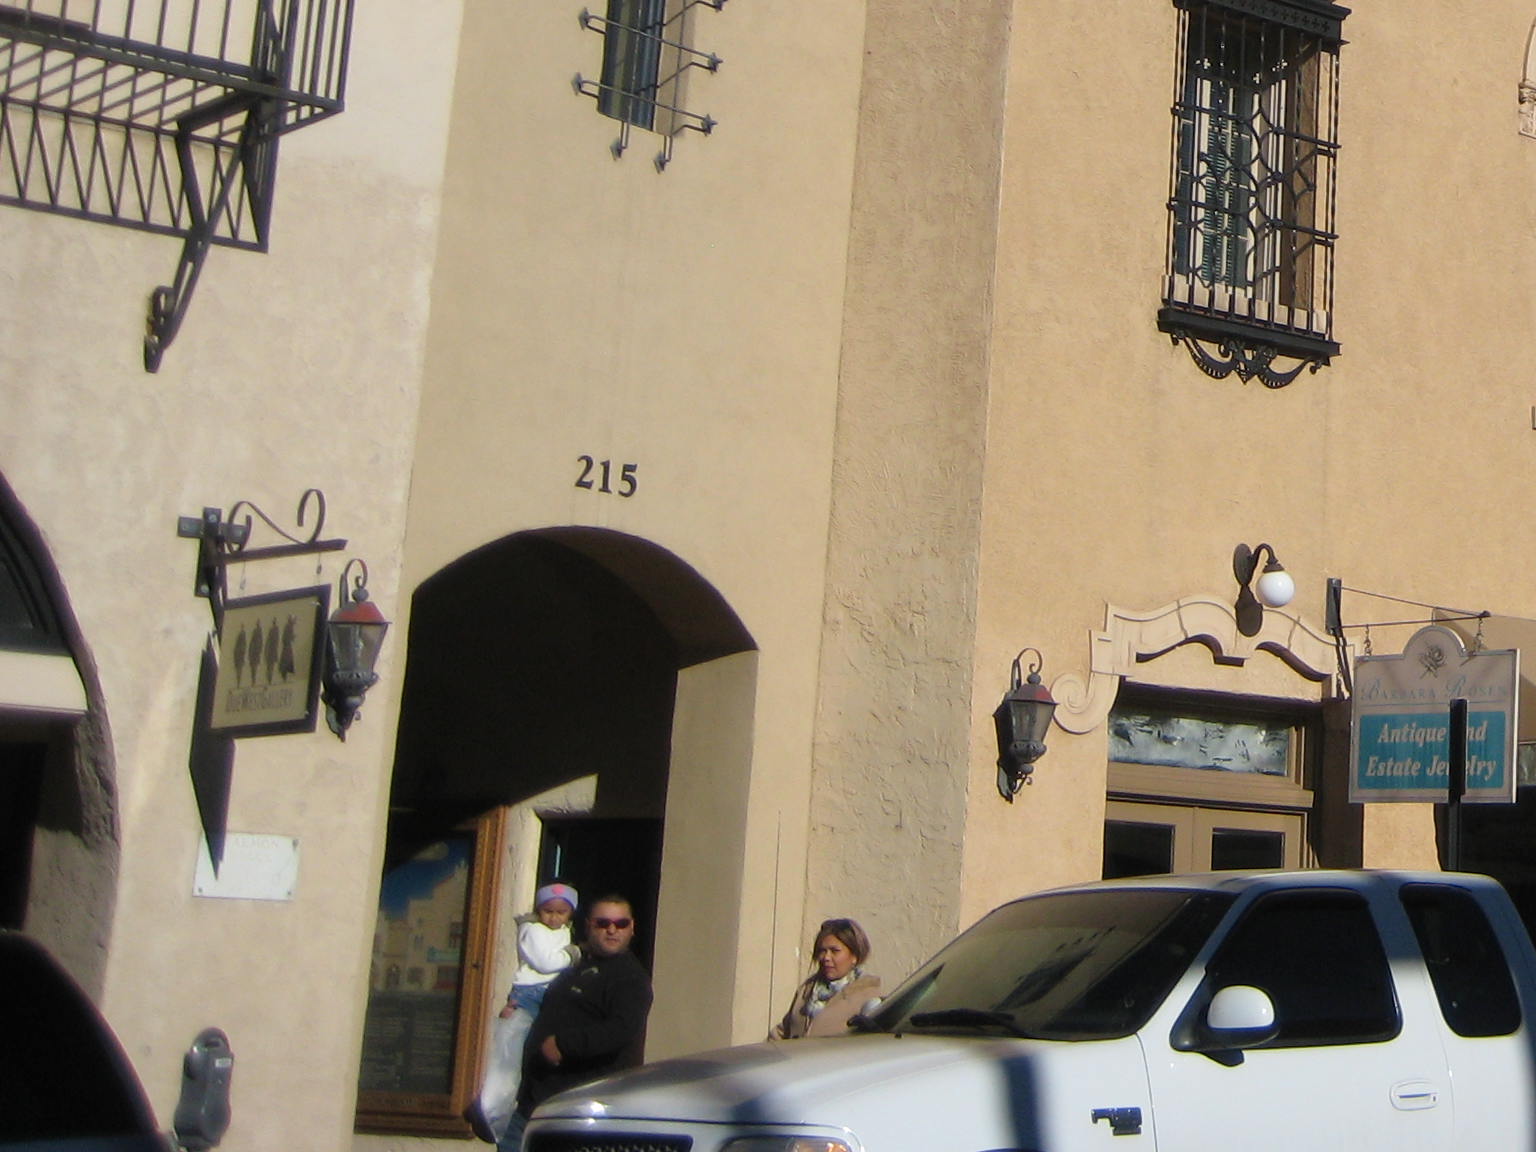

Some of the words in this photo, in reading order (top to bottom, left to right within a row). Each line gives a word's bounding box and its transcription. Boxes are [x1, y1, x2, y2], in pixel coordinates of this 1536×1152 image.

[575, 454, 638, 497] 215
[1377, 721, 1448, 747] Antique
[1365, 756, 1421, 777] Estate
